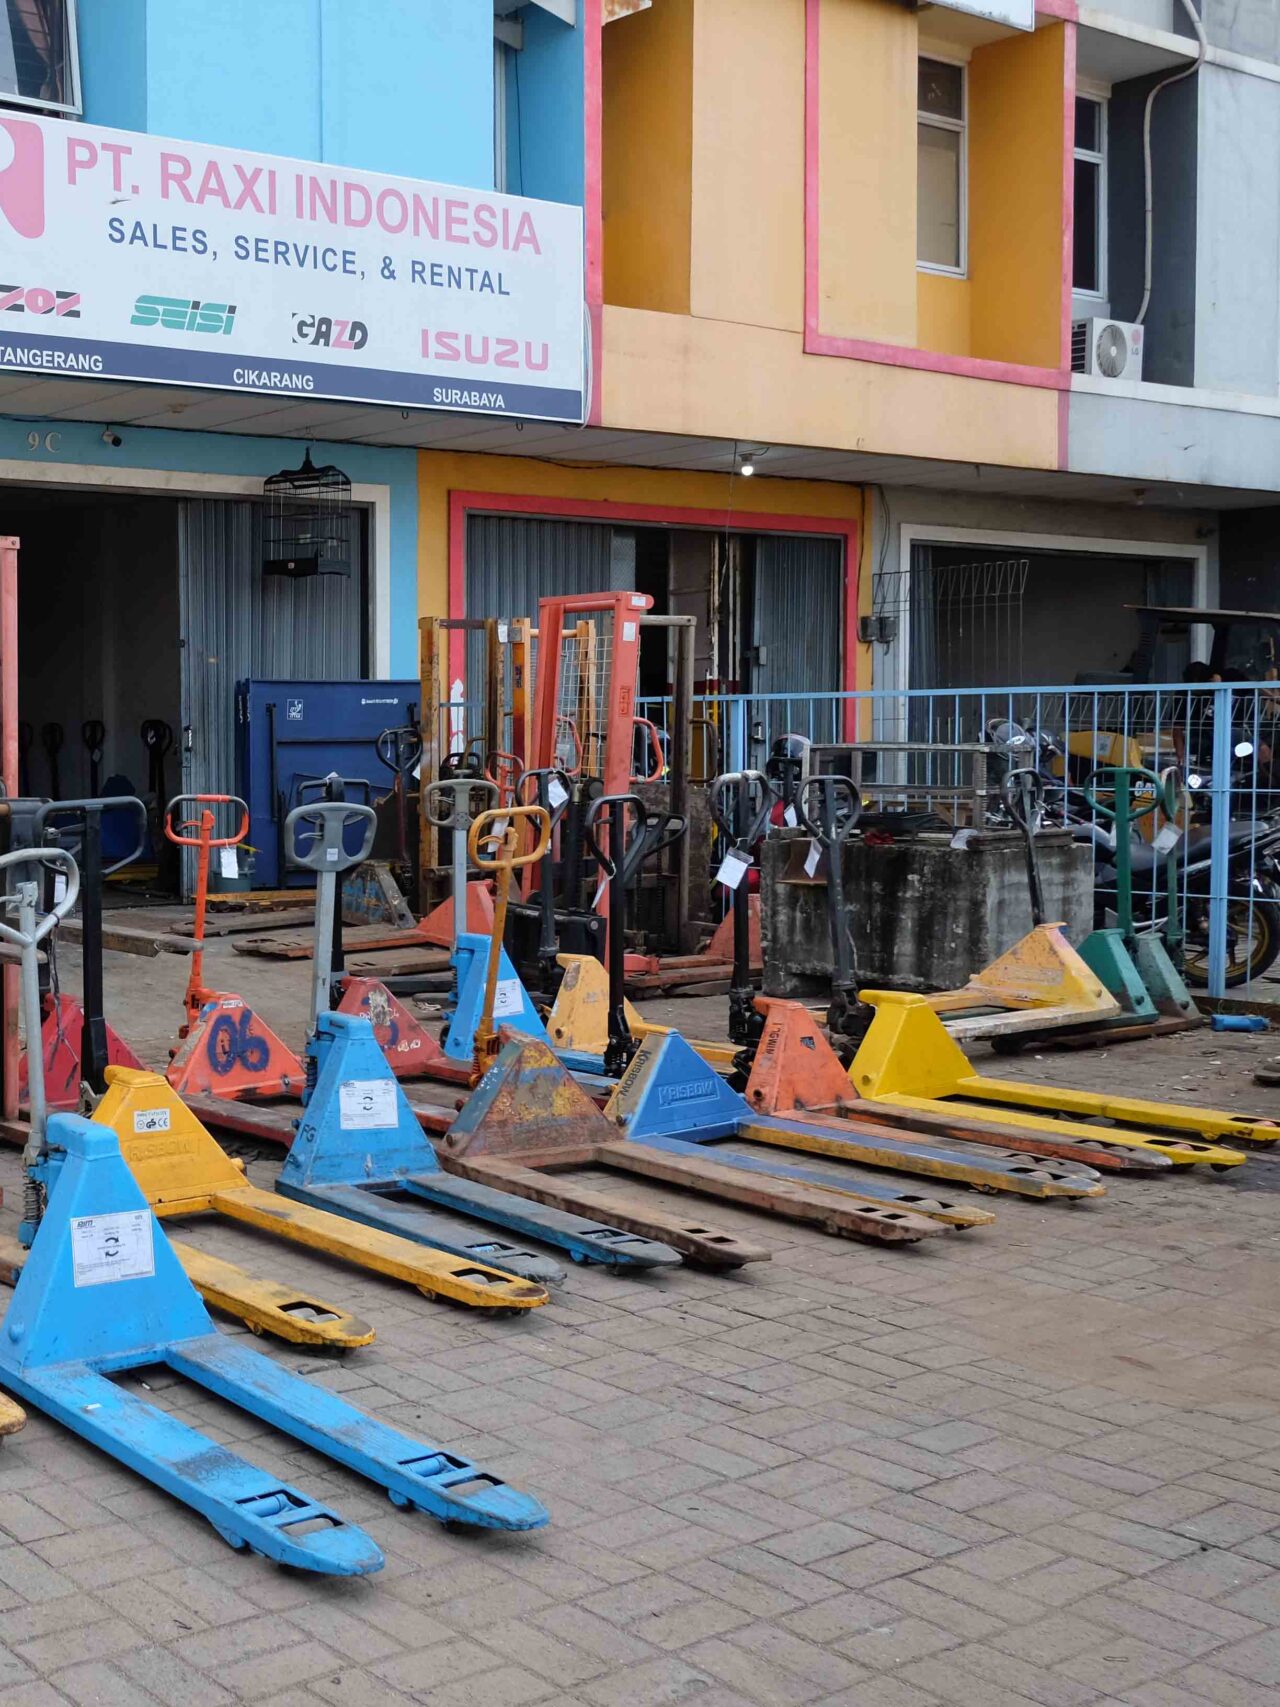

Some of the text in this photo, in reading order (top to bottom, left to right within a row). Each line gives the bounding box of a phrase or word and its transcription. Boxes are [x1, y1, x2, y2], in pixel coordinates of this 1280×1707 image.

[67, 137, 542, 256] PT. RAXI INDONESIA
[108, 217, 511, 296] SALES, SERVICE, & RENTAL
[421, 328, 549, 371] ISUZU
[233, 368, 314, 391] CIKARANG
[433, 387, 506, 409] SURABAYA
[27, 431, 62, 453] 9C
[207, 1008, 270, 1077] 06
[620, 1049, 652, 1097] KRISBOW
